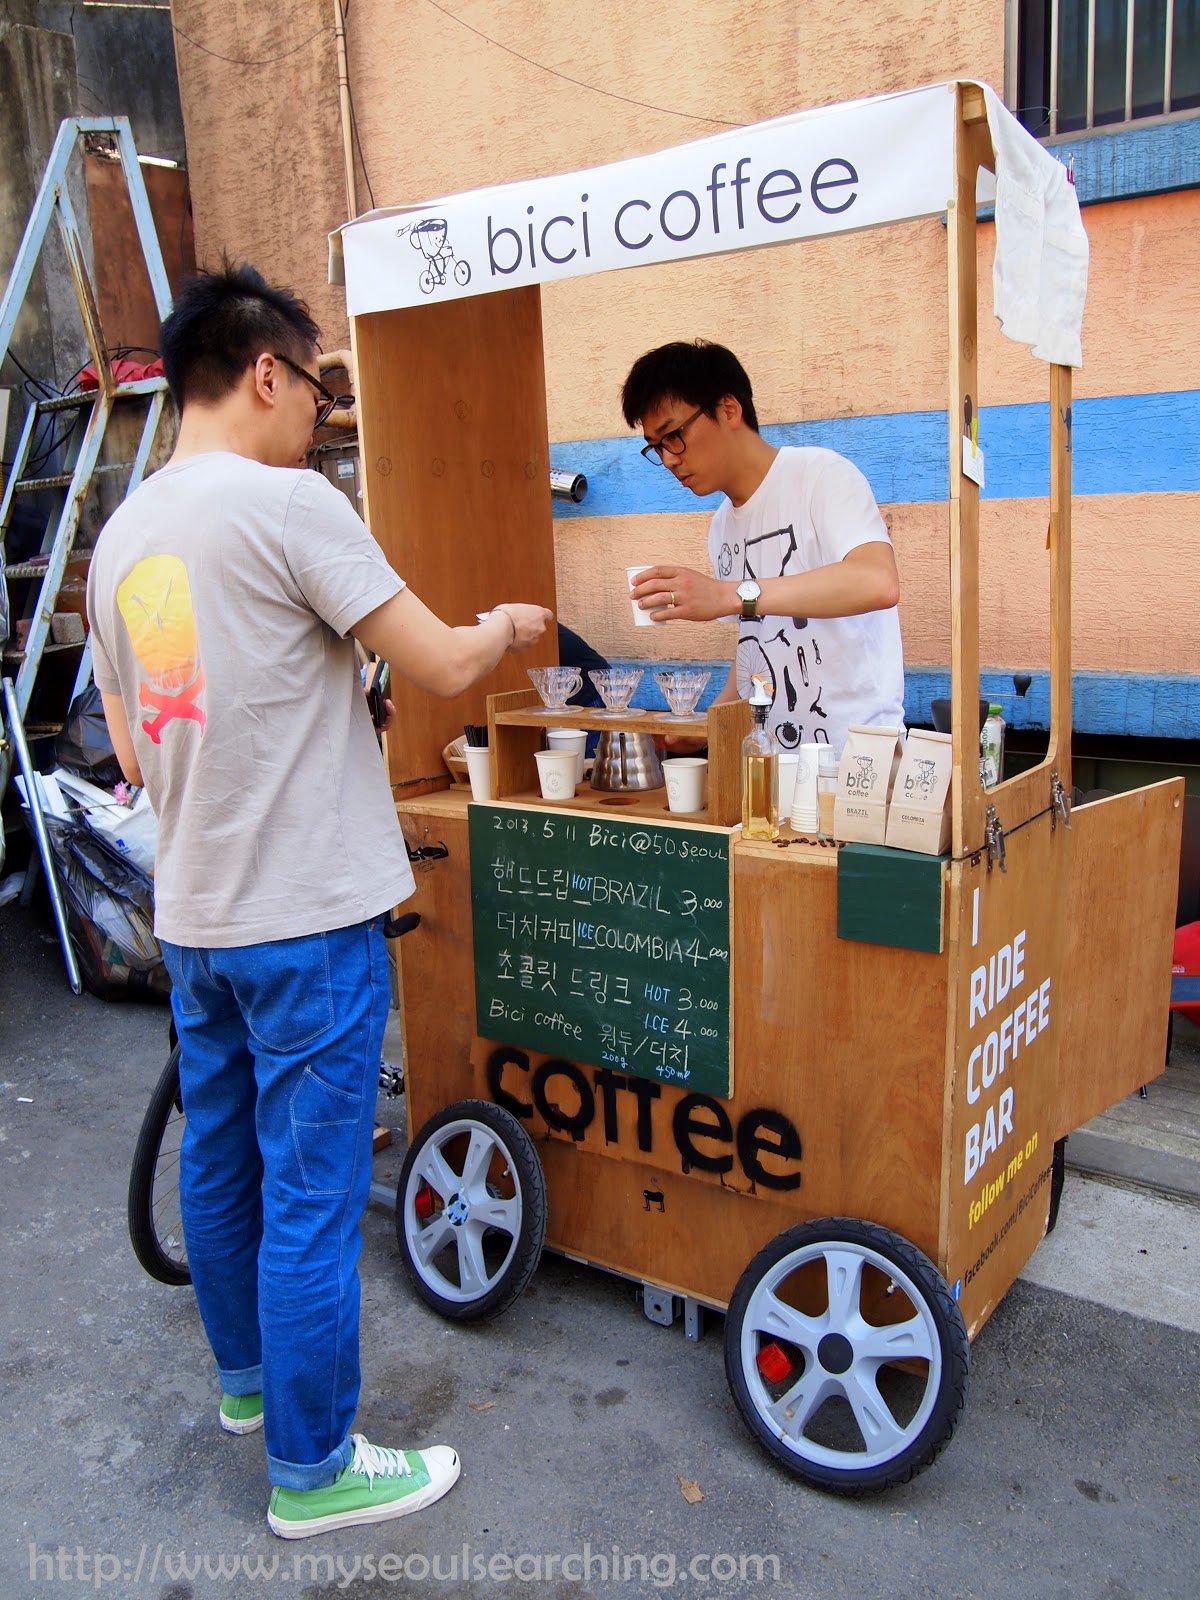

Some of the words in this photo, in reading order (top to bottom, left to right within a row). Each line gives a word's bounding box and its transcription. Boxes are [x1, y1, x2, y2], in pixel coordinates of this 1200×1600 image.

[487, 193, 591, 275] bici
[615, 157, 860, 250] coffee
[846, 772, 875, 791] bici
[847, 789, 869, 798] coffee
[904, 774, 935, 794] bici
[846, 807, 869, 816] BRAZIL
[901, 814, 925, 823] COLOMBIA
[490, 856, 570, 901] 핸드드립
[572, 872, 594, 892] HOT
[592, 876, 671, 915] BRAZIL
[497, 911, 577, 948] 더치커피
[577, 921, 596, 941] ICE
[595, 924, 684, 964] COLOMBIA
[972, 886, 980, 947] I
[497, 948, 558, 997] 초콜릿
[569, 968, 632, 1005] 드링크
[644, 982, 671, 1004] HOT
[969, 928, 1026, 1029] RIDE
[489, 998, 526, 1020] Bici
[534, 1011, 583, 1041] coffee
[643, 1012, 670, 1034] ICE
[966, 976, 1051, 1105] COFFEE
[486, 1046, 802, 1192] coffee
[964, 1086, 1014, 1185] BAR
[968, 1170, 1006, 1231] follow
[1007, 1149, 1024, 1184] me
[1025, 1131, 1038, 1160] on
